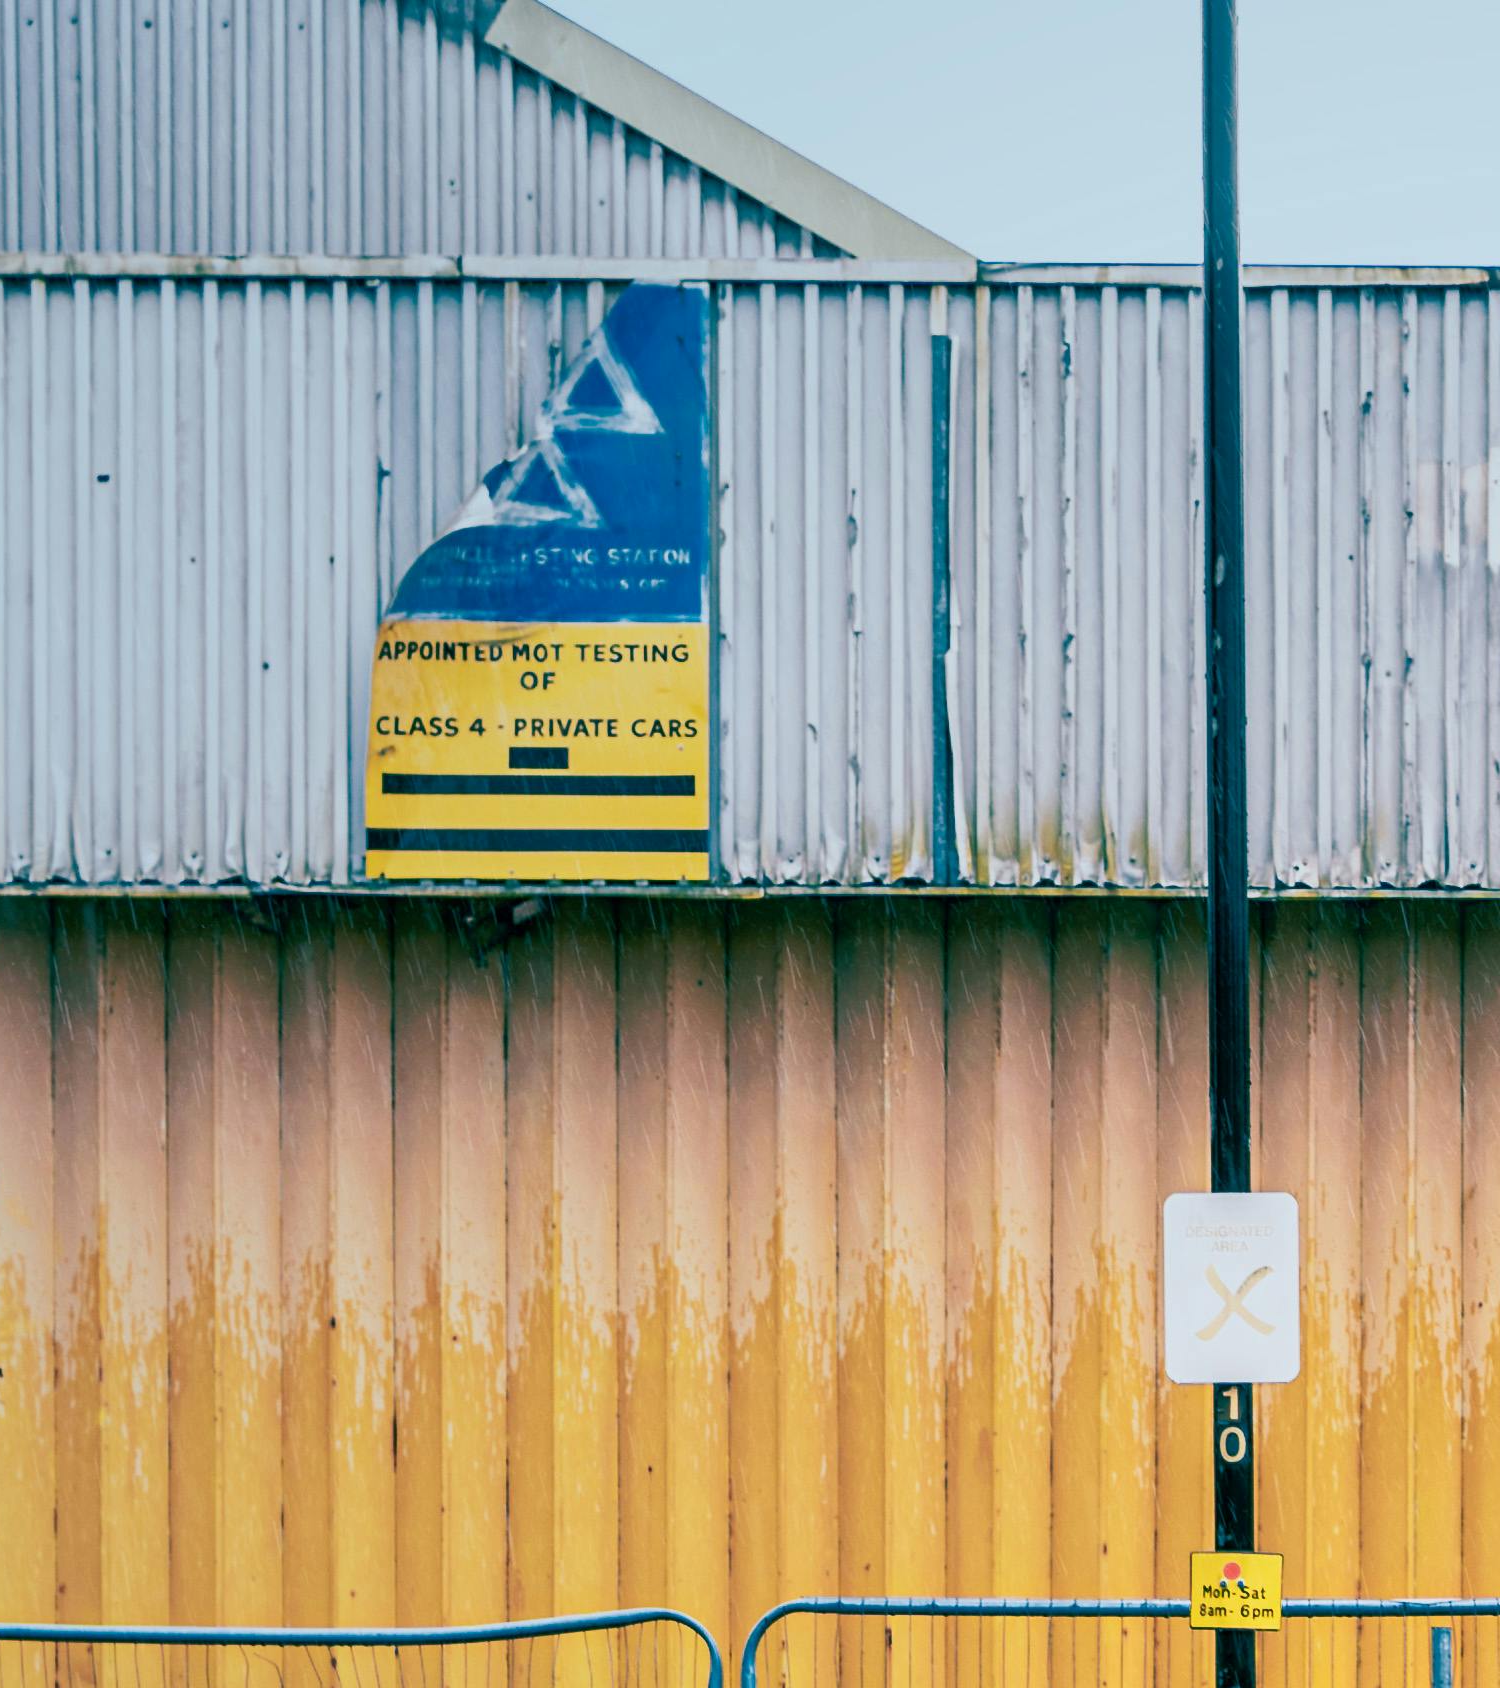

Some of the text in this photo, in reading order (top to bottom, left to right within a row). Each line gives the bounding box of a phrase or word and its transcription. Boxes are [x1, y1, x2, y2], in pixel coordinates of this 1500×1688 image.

[377, 641, 690, 663] APPOINTED MOT TESTING
[520, 671, 557, 691] OF
[376, 716, 460, 737] CLASS
[469, 717, 487, 738] 4
[514, 718, 620, 738] PRIVATE
[631, 718, 699, 739] CARS
